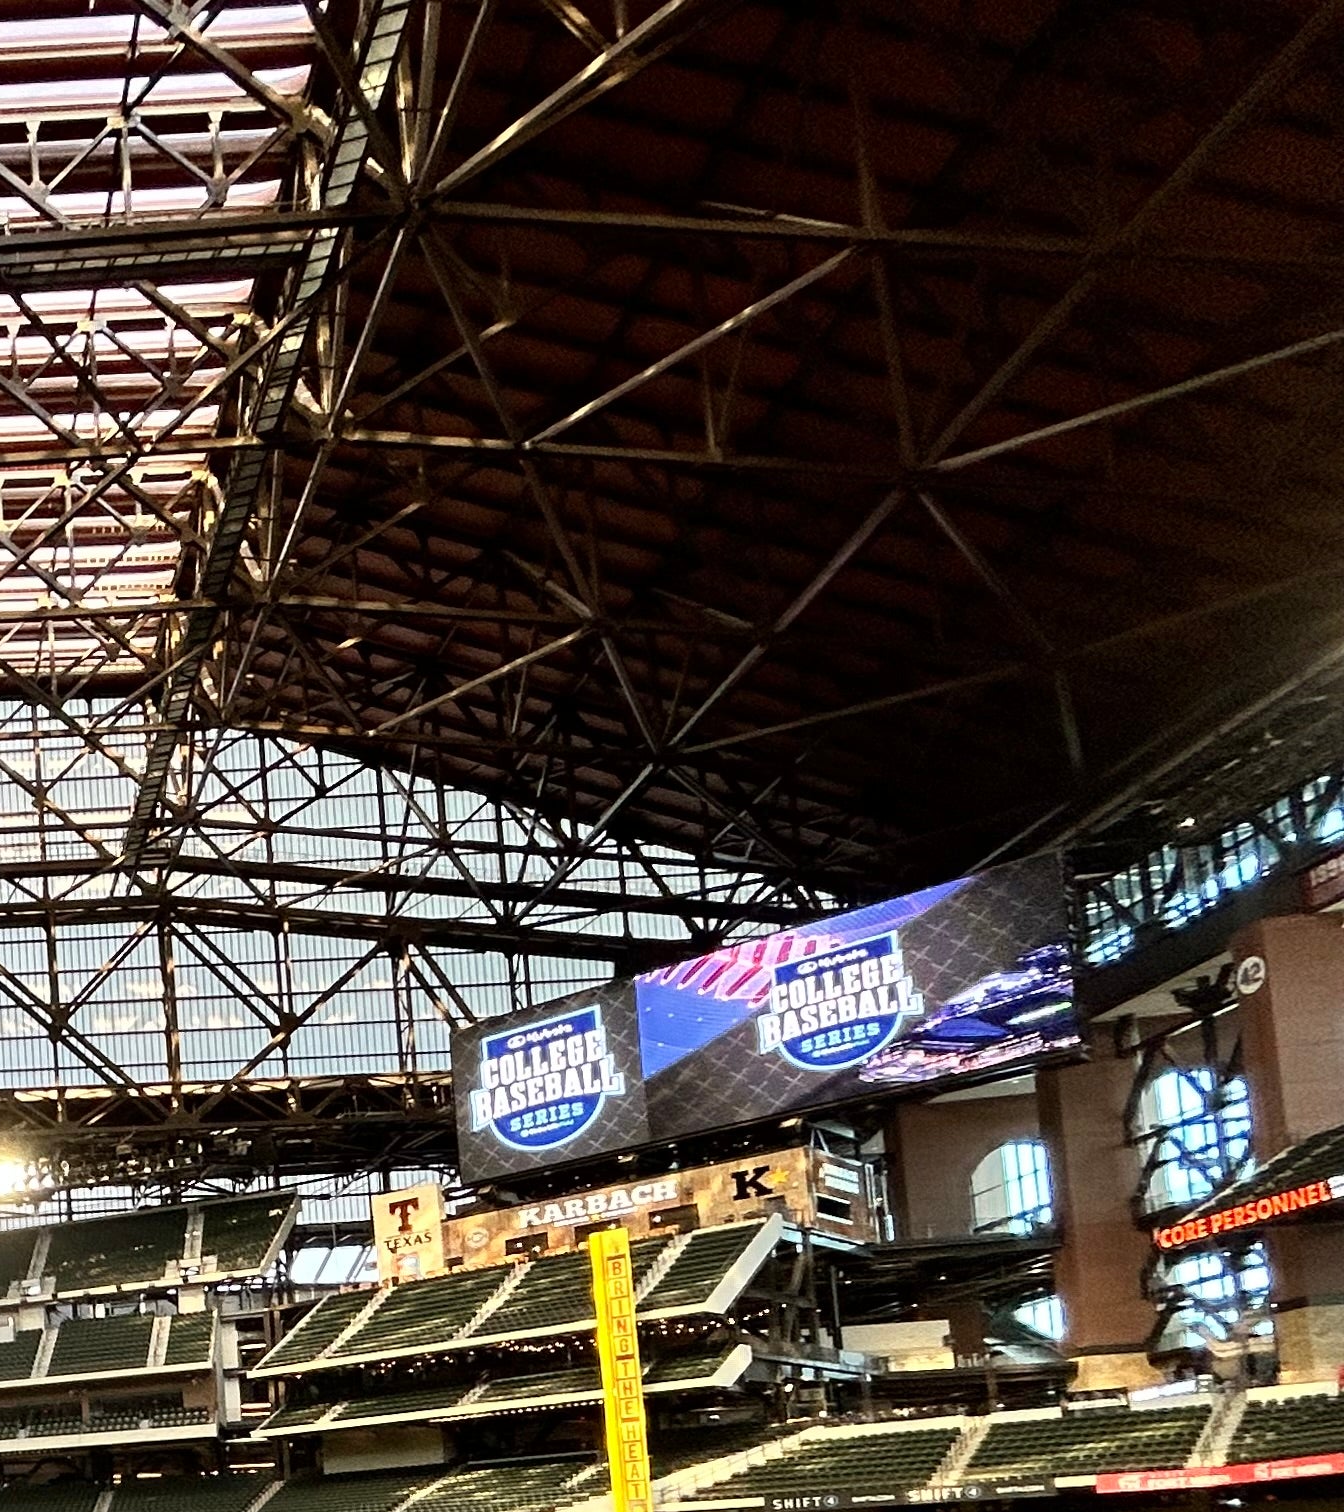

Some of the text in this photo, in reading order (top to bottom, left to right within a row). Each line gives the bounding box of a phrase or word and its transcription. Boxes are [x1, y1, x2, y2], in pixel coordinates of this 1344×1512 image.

[772, 953, 904, 1014] COLLEGE
[761, 981, 919, 1049] BASEBALL
[802, 1022, 881, 1053] SERIES
[482, 1030, 604, 1090] COLLEGE
[473, 1058, 620, 1127] BASEBALL
[510, 1102, 585, 1131] SERIES
[517, 1179, 678, 1229] KARBACH
[731, 1165, 773, 1200] K
[384, 1232, 433, 1251] TEXAS
[389, 1197, 420, 1232] T
[1159, 1219, 1208, 1248] CORE
[1210, 1181, 1331, 1234] PERSONNEL
[612, 1261, 642, 1499] BRING THE HEAT
